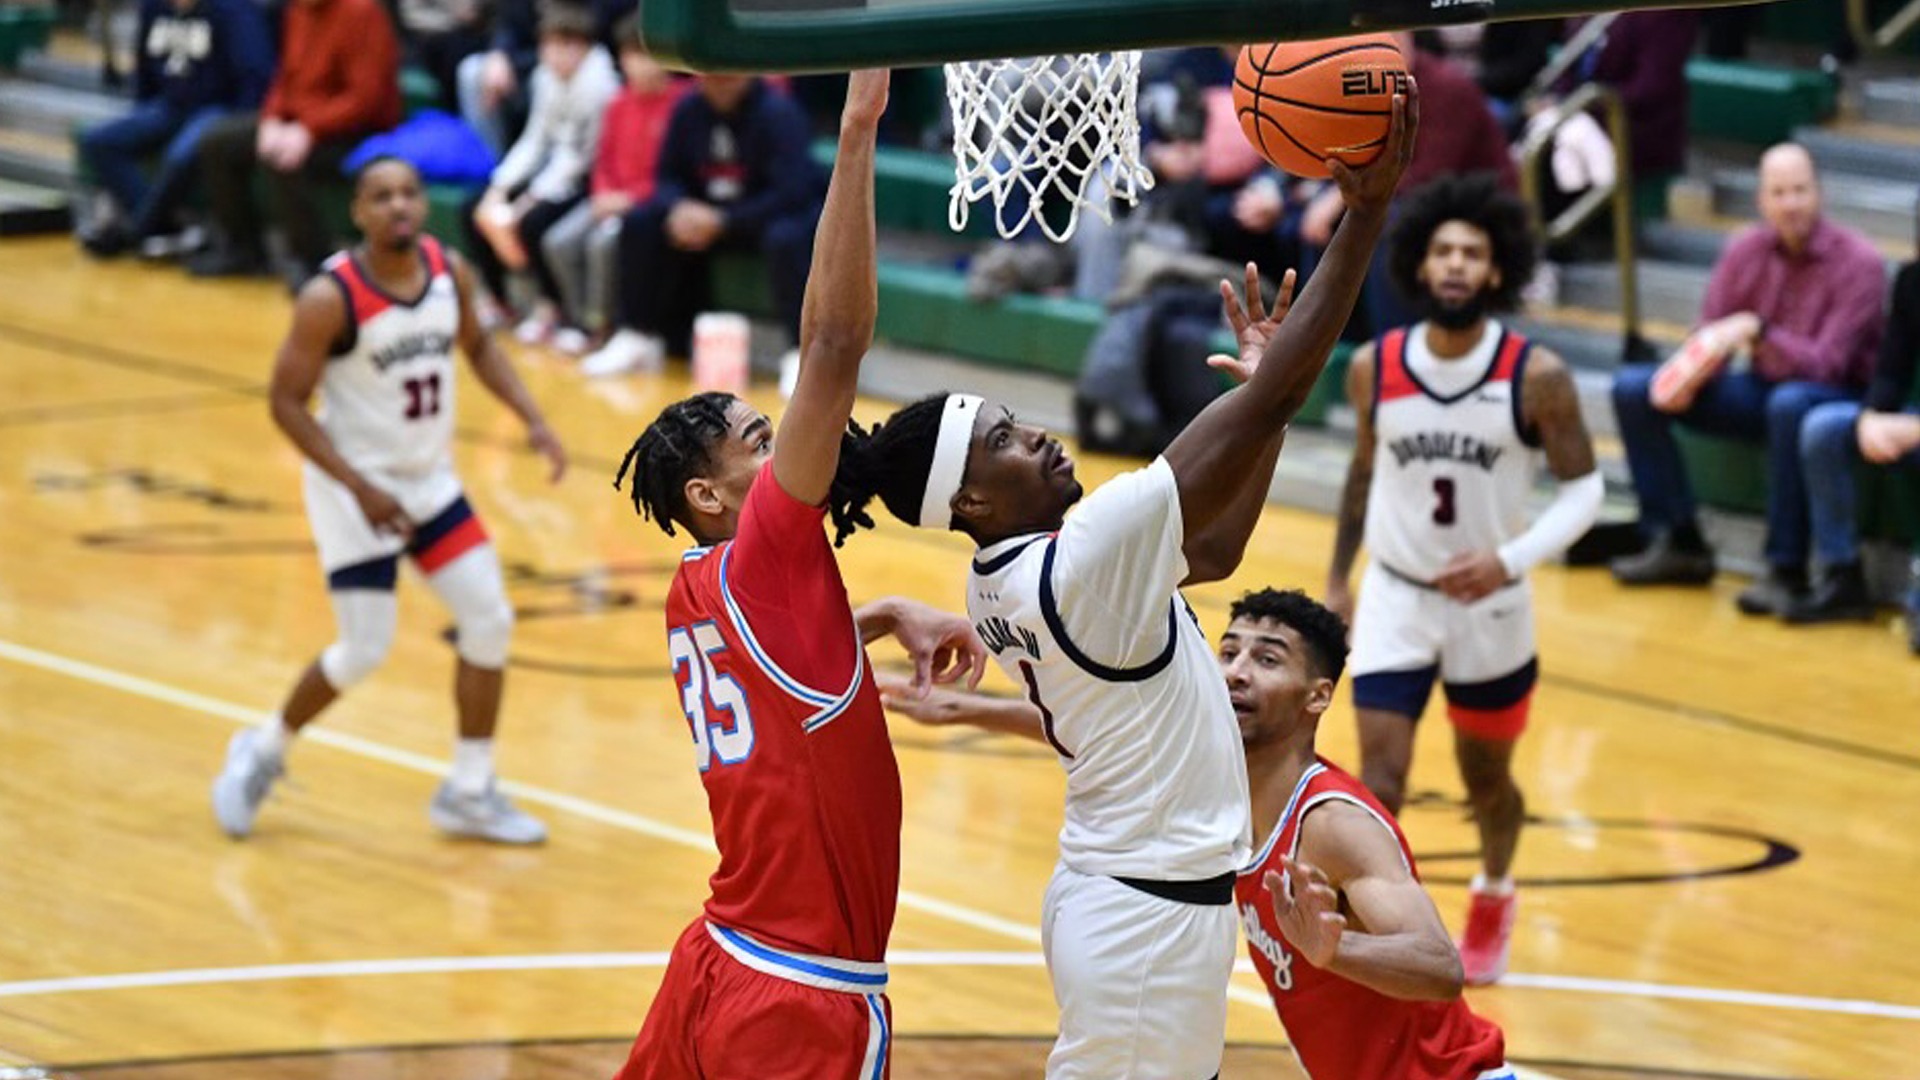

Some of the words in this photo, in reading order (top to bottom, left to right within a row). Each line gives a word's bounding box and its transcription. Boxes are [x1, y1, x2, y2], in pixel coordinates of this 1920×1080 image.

[1341, 69, 1408, 97] ELITE
[1432, 477, 1456, 527] 3
[669, 618, 755, 772] 35
[1018, 659, 1076, 760] 1
